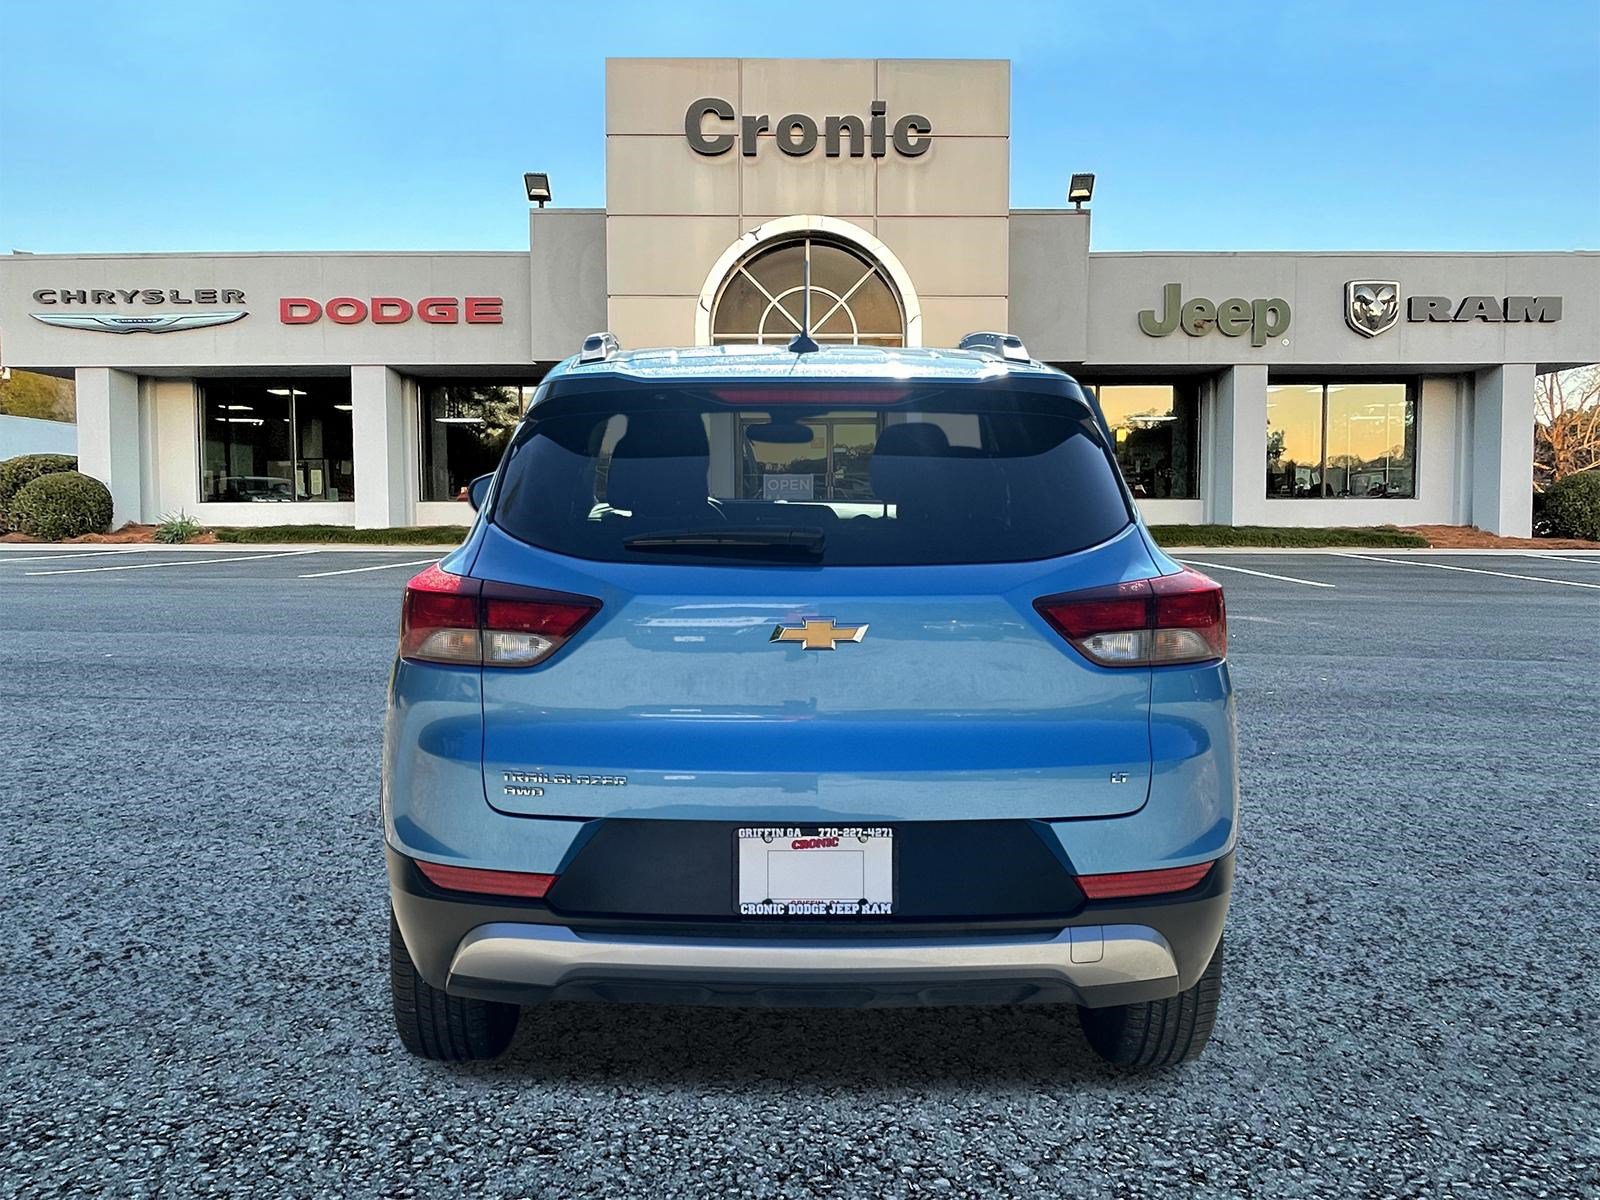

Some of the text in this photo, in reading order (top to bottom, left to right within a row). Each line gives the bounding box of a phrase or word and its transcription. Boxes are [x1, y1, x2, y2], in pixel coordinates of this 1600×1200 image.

[684, 97, 933, 158] Cronic
[33, 288, 247, 304] CHRYSLER
[279, 297, 504, 325] DODGE
[1138, 283, 1292, 347] Jeep
[1407, 295, 1563, 323] RAM
[767, 479, 810, 491] OPEN
[1110, 772, 1130, 784] LT
[504, 786, 545, 797] AWD
[738, 828, 893, 838] GRIFFIN GA 770-227-4271
[791, 837, 840, 850] CRONIC
[740, 903, 892, 915] CRONIC DODGE JEEP RAM
